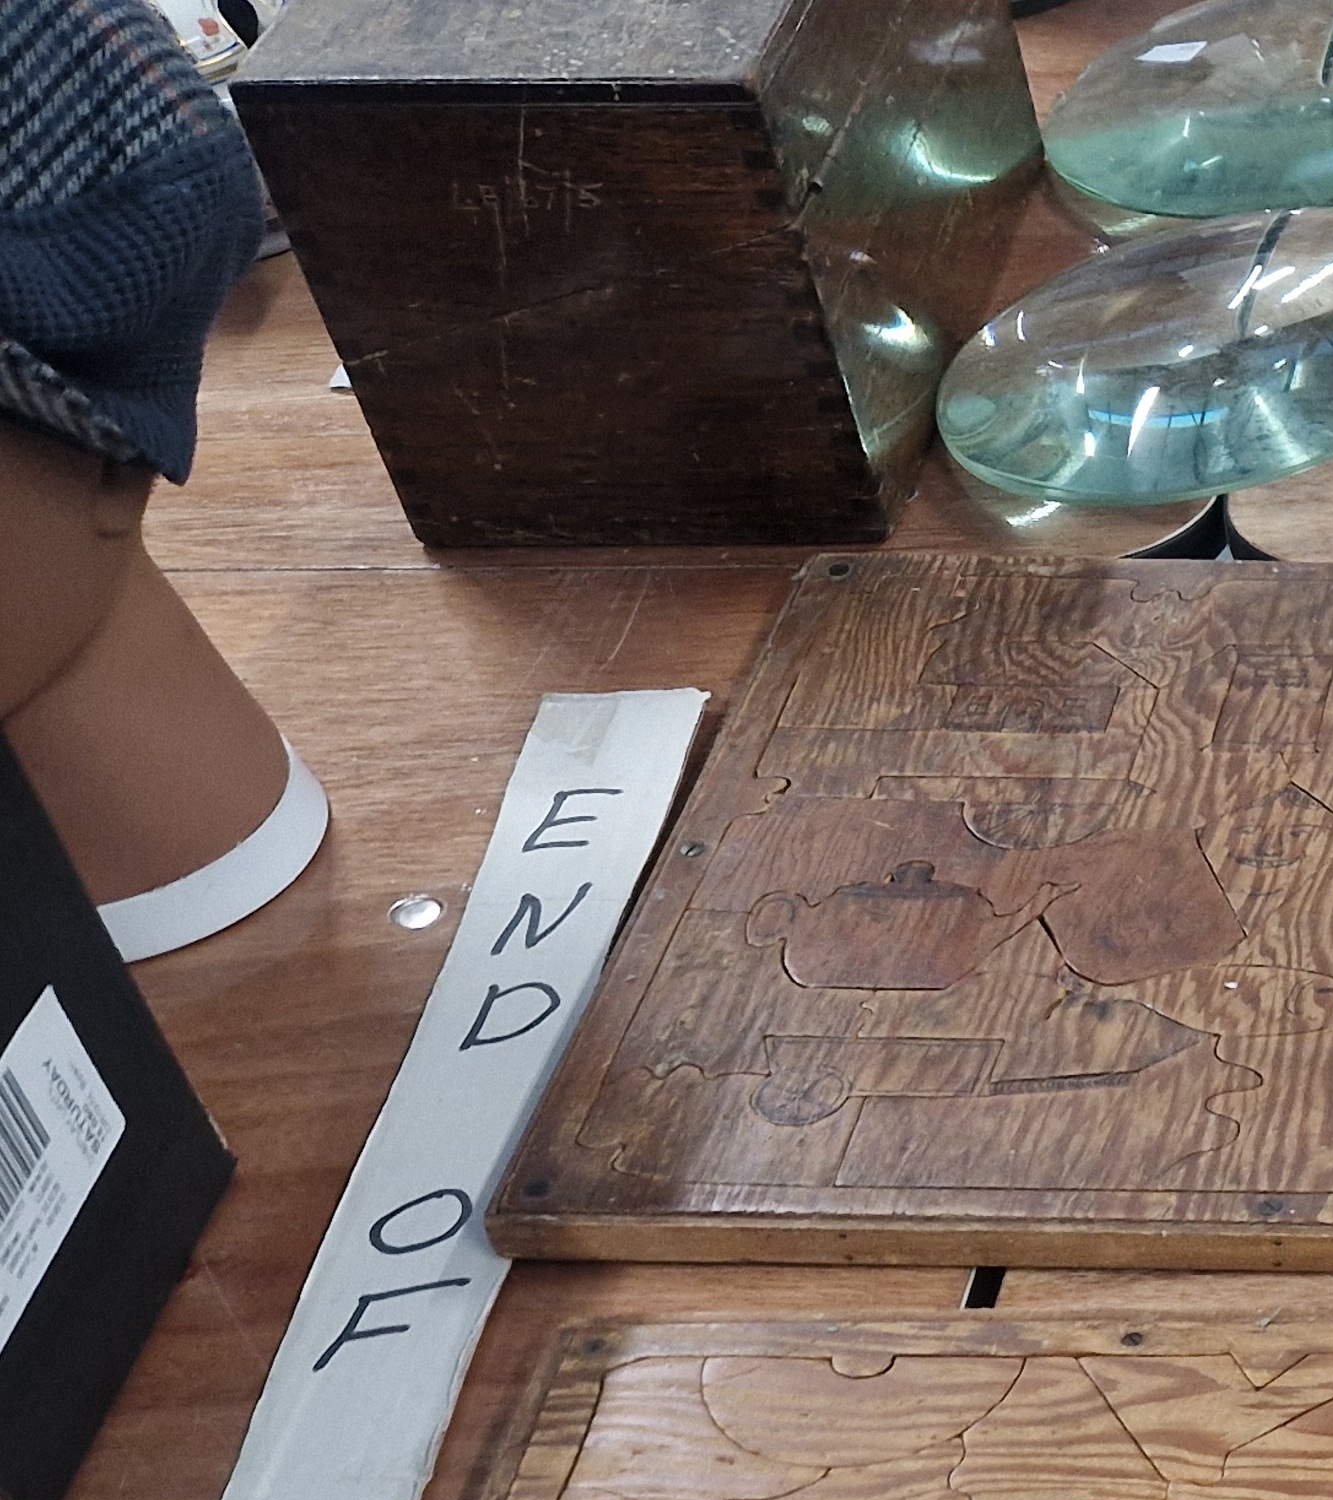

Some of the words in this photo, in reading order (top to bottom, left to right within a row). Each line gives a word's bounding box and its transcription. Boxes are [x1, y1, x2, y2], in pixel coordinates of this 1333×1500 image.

[460, 785, 624, 1053] END
[42, 1057, 100, 1155] SATURDAY
[313, 1187, 472, 1373] OF
